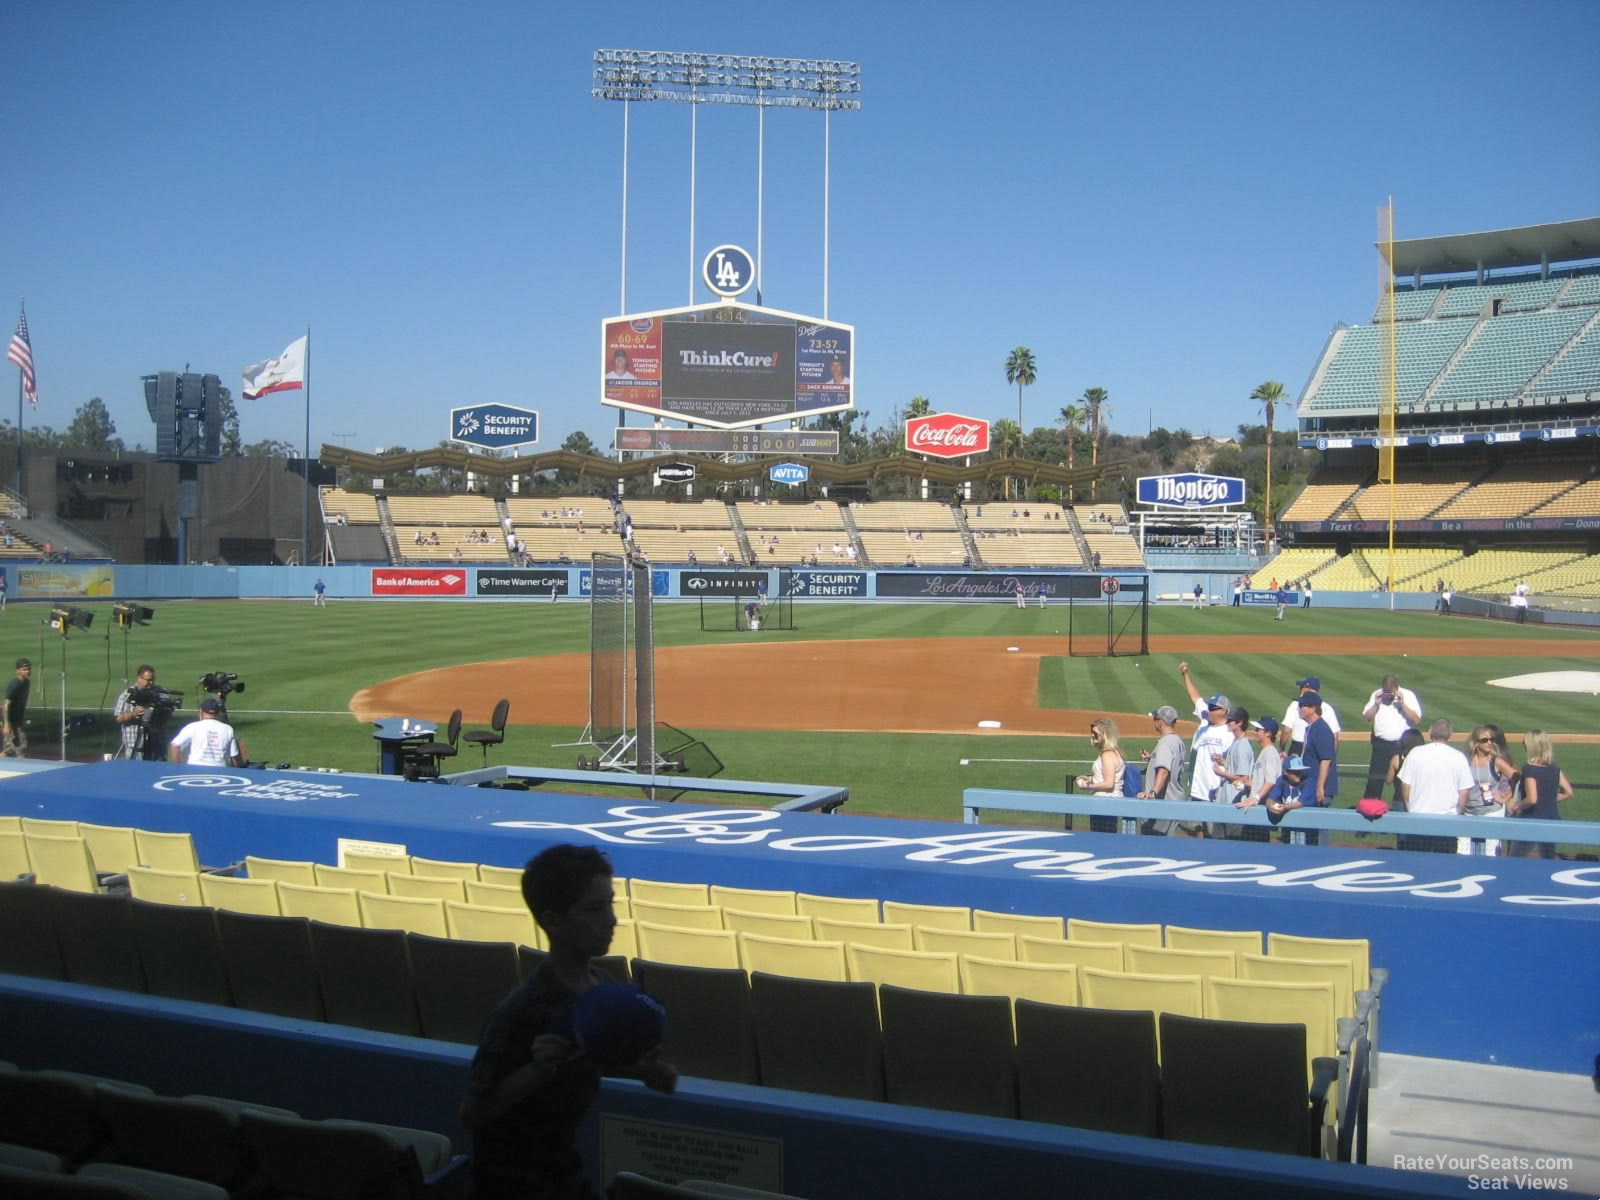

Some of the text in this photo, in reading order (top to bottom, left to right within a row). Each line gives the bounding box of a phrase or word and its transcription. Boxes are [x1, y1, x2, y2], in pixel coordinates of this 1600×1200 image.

[716, 253, 740, 287] LA
[798, 325, 824, 336] Dodge
[618, 335, 648, 344] 60-69
[810, 340, 838, 348] 73-57
[680, 350, 779, 368] ThinkCure!
[1475, 396, 1568, 410] STADIUM
[484, 415, 532, 425] SECURITY
[913, 424, 981, 446] Coca-Cola
[763, 440, 795, 449] 0 0 0
[800, 439, 835, 447] SUBWAY
[1156, 478, 1228, 502] Montejo
[377, 577, 440, 586] Bank of America
[490, 577, 504, 586] Time
[505, 578, 534, 586] Warner
[809, 574, 860, 584] SECURITY
[920, 577, 1056, 600] Los Angeles Ddgrs
[268, 780, 343, 790] Time
[218, 788, 307, 801] Cable
[243, 784, 360, 798] Warner
[490, 806, 783, 844] Los
[768, 830, 1496, 898] Angeles
